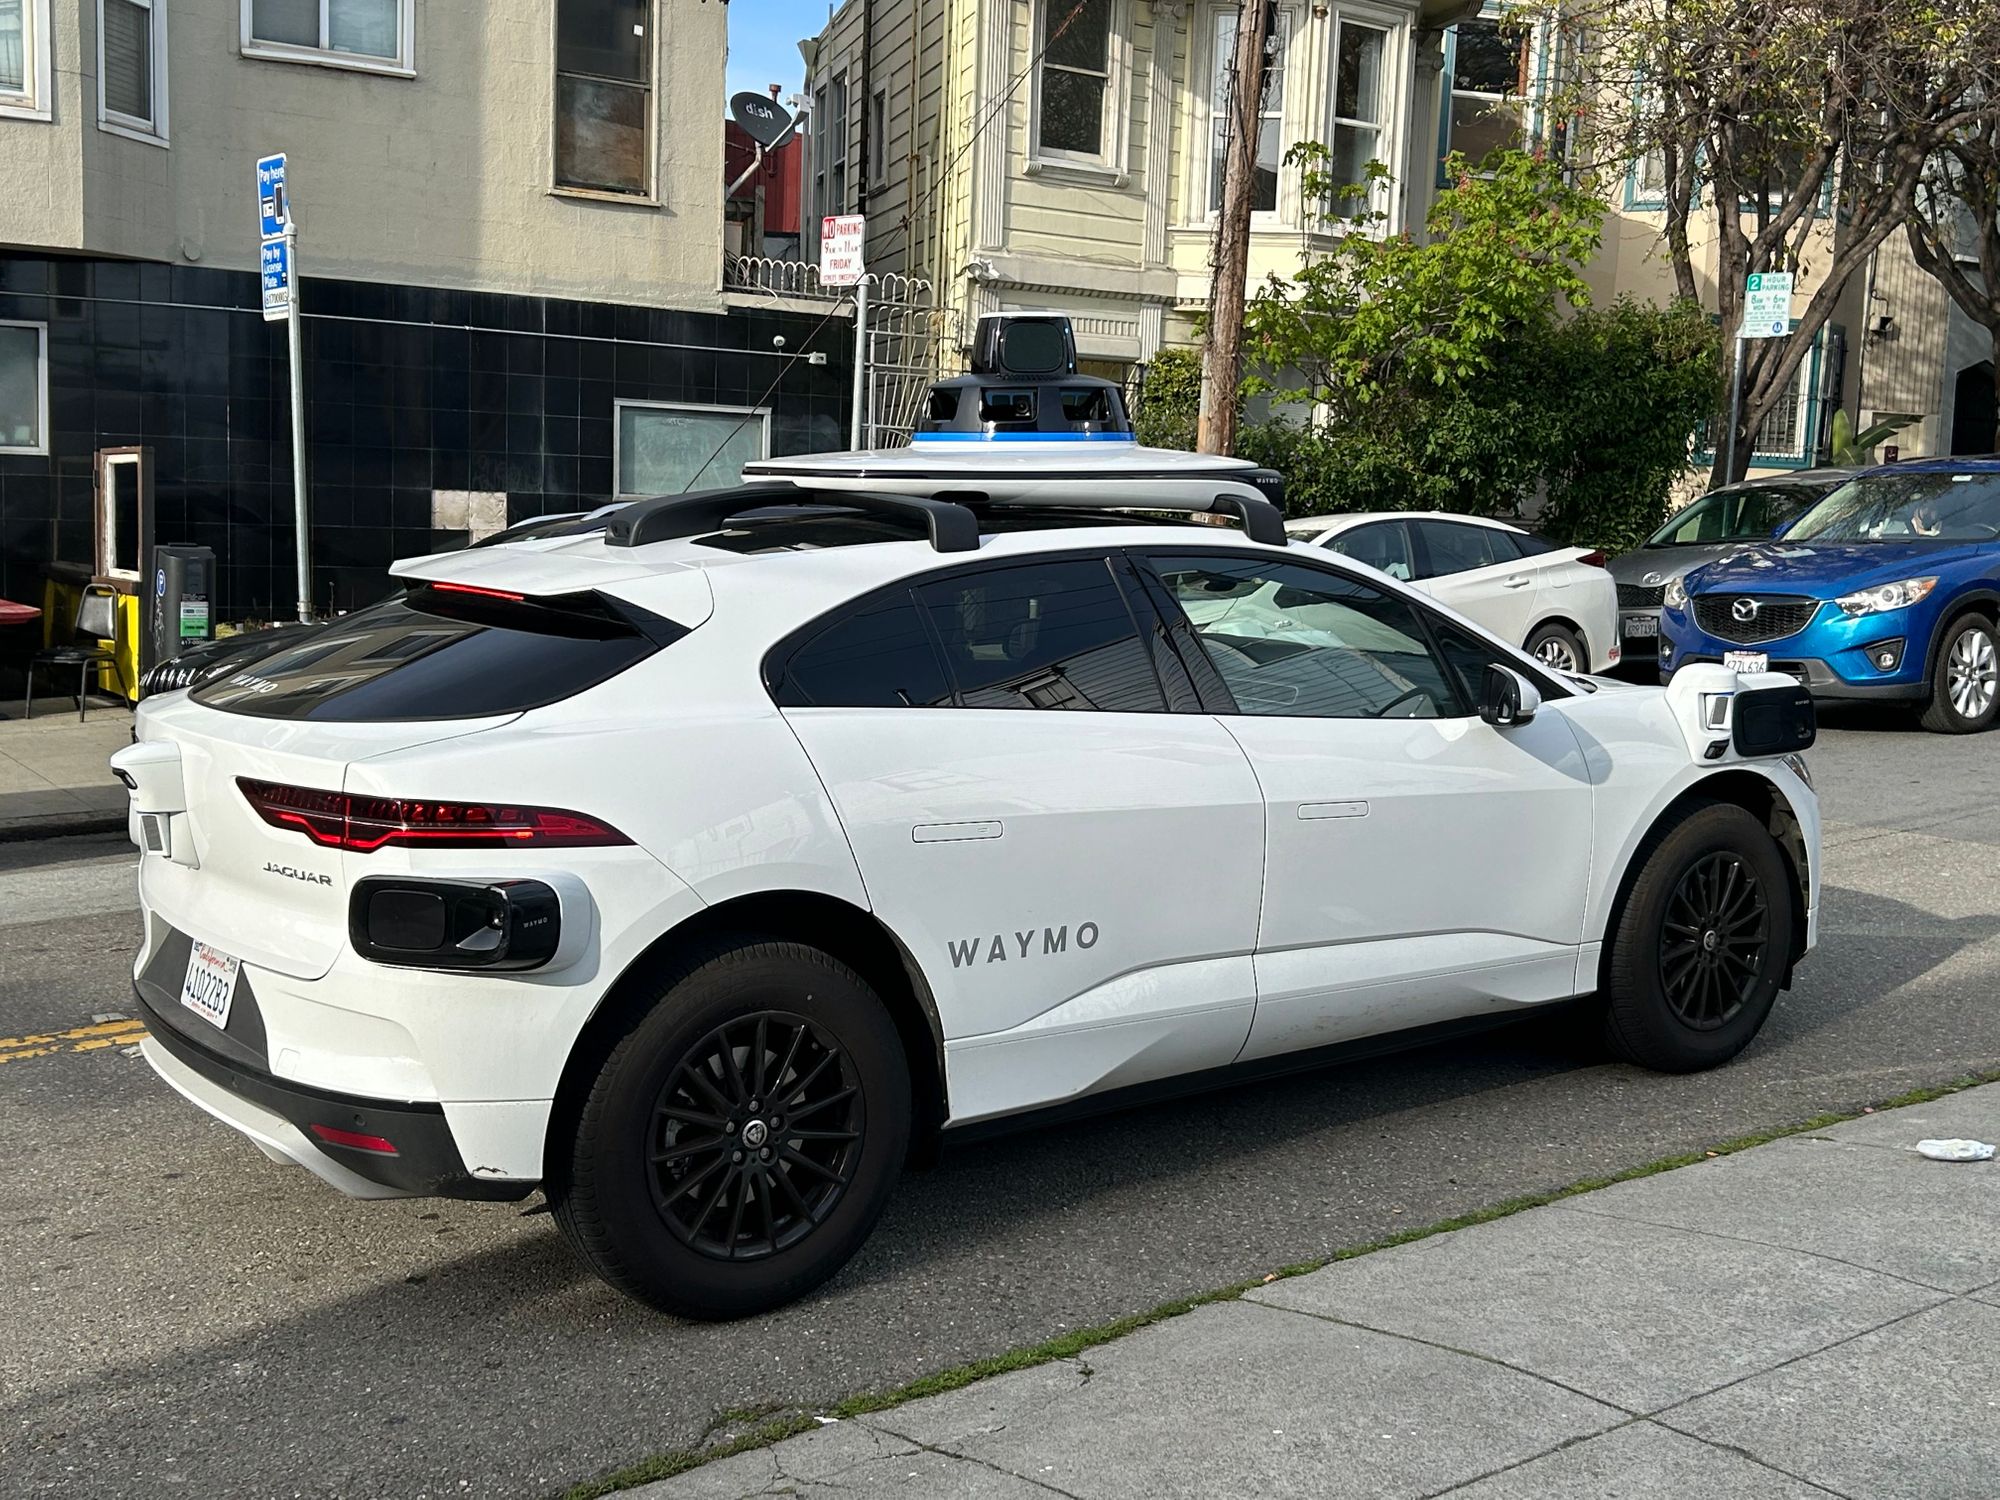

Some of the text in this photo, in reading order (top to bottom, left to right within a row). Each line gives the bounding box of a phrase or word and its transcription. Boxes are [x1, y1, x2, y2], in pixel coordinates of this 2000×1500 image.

[745, 102, 774, 119] dish
[260, 165, 284, 185] Pay here
[823, 220, 861, 238] NO PARKING
[263, 246, 280, 263] Pay by
[829, 259, 852, 270] FRIDAY
[264, 275, 278, 288] Plate
[1750, 276, 1760, 290] 2
[1761, 283, 1790, 291] PARKING
[229, 674, 279, 693] WAYMO
[262, 861, 333, 887] JAGUAR
[523, 916, 548, 928] WAYMO
[947, 921, 1099, 968] WAYMO
